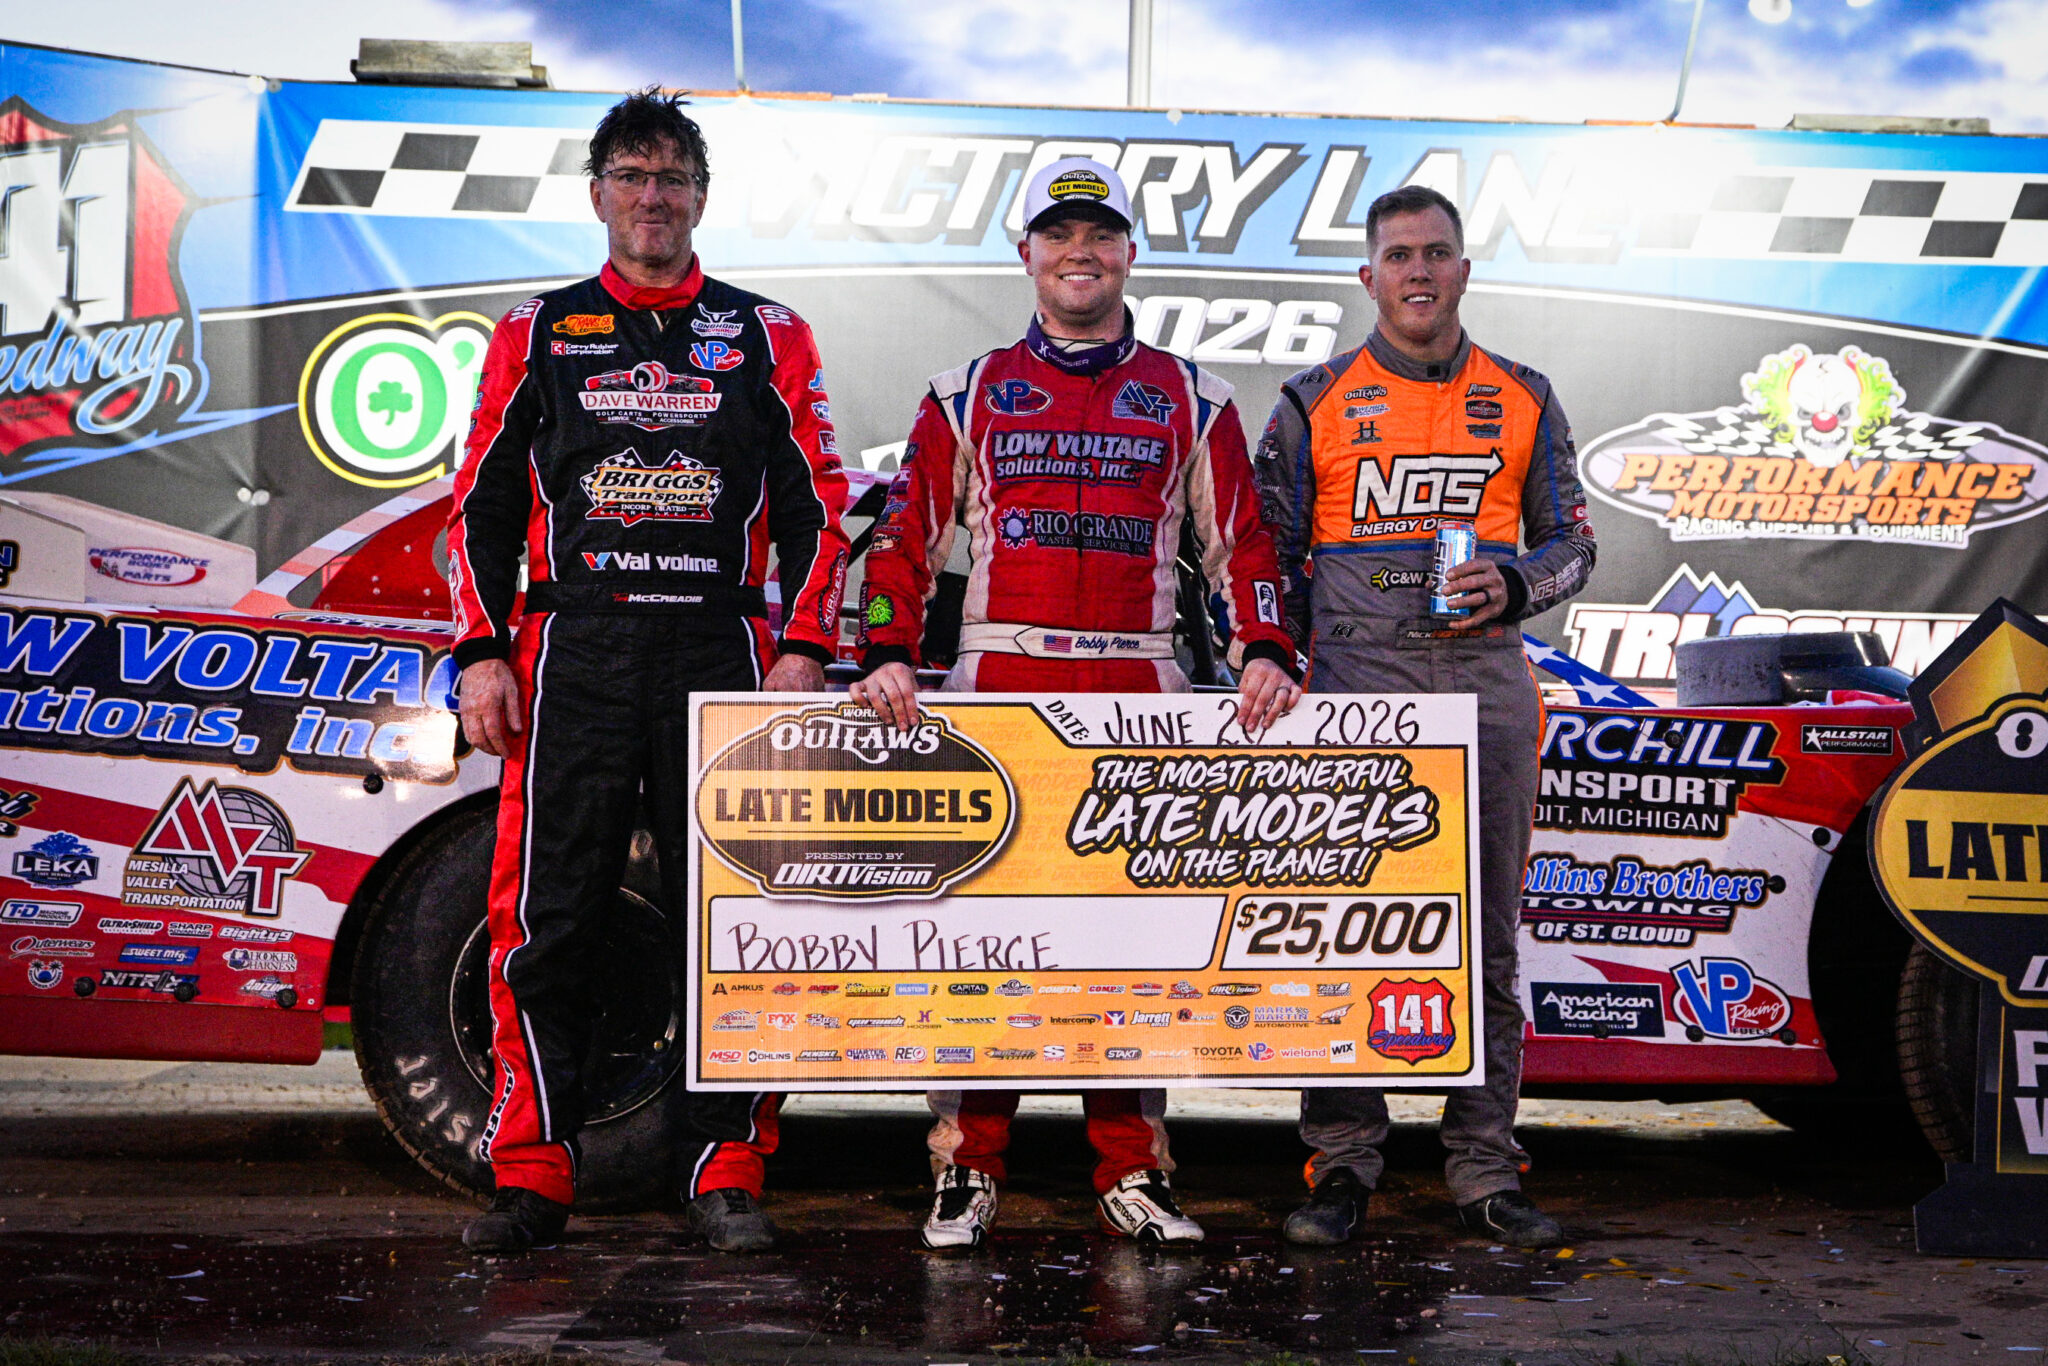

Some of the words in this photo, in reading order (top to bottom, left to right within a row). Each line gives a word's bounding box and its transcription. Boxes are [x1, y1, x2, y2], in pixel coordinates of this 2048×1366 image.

[1052, 184, 1070, 193] LATE
[1072, 183, 1106, 193] MODELS
[692, 321, 742, 331] LONGHORN
[1122, 294, 1342, 364] 026
[690, 341, 729, 370] VP
[585, 394, 634, 408] DAVE
[635, 395, 717, 409] WARREN
[986, 379, 1031, 414] VP
[994, 432, 1051, 459] LOW
[1054, 432, 1166, 463] VOLTAGE
[600, 470, 709, 490] BRIGGS
[996, 459, 1095, 479] solutions,
[1100, 462, 1136, 480] inc.
[1612, 452, 2034, 500] PERFORMANCE
[1354, 449, 1503, 520] NOS
[1665, 490, 1977, 526] MOTORSPORTS
[1033, 513, 1070, 536] RIO
[1080, 513, 1154, 545] GRANDE
[1351, 519, 1418, 538] ENERGY
[1676, 517, 1745, 536] RACING
[1749, 521, 1839, 536] SUPPLIES
[1859, 523, 1967, 543] EQUIPMENT
[88, 547, 211, 568] PERFORMANCE
[122, 571, 172, 582] PARTS
[1389, 572, 1424, 585] C&W
[1075, 636, 1109, 654] Bobby
[1109, 637, 1141, 651] Pierce
[842, 707, 880, 719] WORL
[1043, 700, 1090, 741] DATE:
[1104, 701, 1194, 746] JUNE
[1314, 700, 1421, 747] 2026
[1541, 713, 1775, 771] RCHILL
[1819, 729, 1888, 741] ALLSTAR
[1820, 739, 1889, 749] PERFORMANCE
[1096, 760, 1153, 789] THE
[1158, 760, 1248, 790] MOST
[1252, 758, 1408, 790] POWERFUL
[1540, 767, 1737, 807] NSPORT
[714, 787, 812, 823] LATE
[823, 787, 993, 823] MODELS
[1071, 793, 1199, 843] LATE
[1208, 792, 1430, 843] MODELS
[1581, 807, 1720, 832] MICHIGAN
[16, 855, 93, 877] LEKA
[804, 851, 882, 861] PRESENTED
[883, 852, 905, 861] BY
[1130, 850, 1171, 878] ON
[1182, 850, 1240, 878] THE
[1243, 847, 1373, 878] PLANET!
[128, 860, 189, 875] MESILLA
[125, 877, 178, 890] VALLEY
[1612, 862, 1764, 902] Brothers
[123, 892, 246, 912] TRANSPORTATION
[1524, 896, 1731, 917] TOWING
[169, 922, 212, 931] SHARP
[1237, 900, 1453, 964] $25,000
[1537, 922, 1567, 938] OF
[1571, 922, 1605, 940] ST.
[1611, 924, 1692, 944] CLOUD
[10, 936, 94, 954] Outerwears
[249, 961, 296, 971] HARNESS
[250, 951, 295, 961] HOOKER
[731, 984, 765, 992] AMKUS
[950, 984, 987, 993] CAPITAL
[1674, 961, 1754, 1036] VP
[1254, 1006, 1293, 1014] MARK
[1541, 990, 1655, 1009] American
[767, 1013, 797, 1024] FOX
[1049, 1016, 1097, 1024] Intercomp
[1253, 1013, 1308, 1021] MARTIN
[1377, 994, 1443, 1034] 141
[1558, 1006, 1638, 1029] Racing
[1729, 1003, 1785, 1026] Racing
[1368, 1030, 1457, 1054] Speedway
[1732, 1027, 1771, 1036] FUELS
[709, 1051, 742, 1060] MSD
[1192, 1046, 1243, 1056] TOYOTA
[1280, 1047, 1327, 1057] wieland
[1331, 1043, 1353, 1055] WIX
